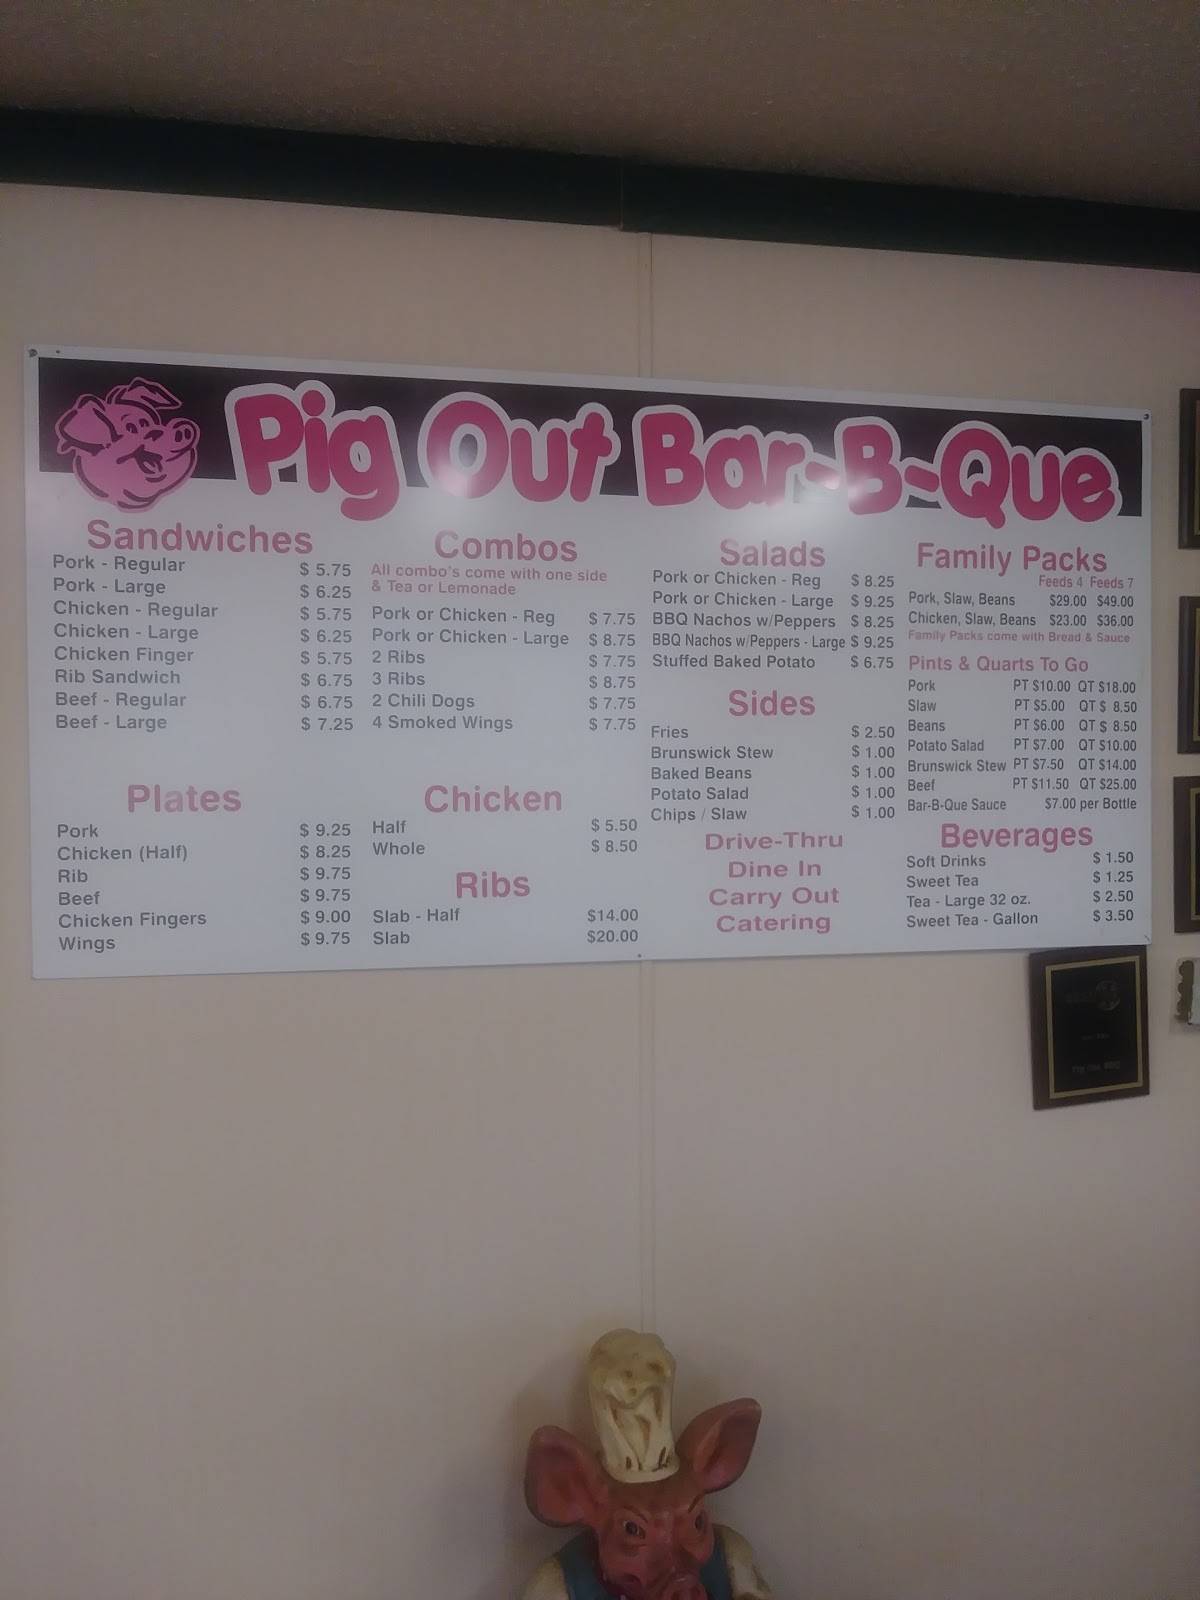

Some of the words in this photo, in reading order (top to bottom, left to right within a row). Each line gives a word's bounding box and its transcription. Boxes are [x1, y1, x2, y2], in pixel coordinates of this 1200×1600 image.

[232, 386, 399, 521] Pig
[424, 399, 616, 502] Out
[638, 411, 1114, 528] Bar-B-Que
[87, 519, 313, 554] Sandwiches
[435, 529, 578, 562] Combos
[720, 539, 826, 569] Salads
[918, 542, 1012, 577] Family
[1023, 545, 1107, 572] Packs
[53, 554, 95, 569] Pork
[114, 556, 185, 574] Regular
[371, 563, 390, 576] All
[395, 565, 460, 578] combo's
[465, 568, 505, 579] come
[510, 568, 541, 580] with
[545, 571, 573, 581] one
[577, 569, 607, 582] side
[653, 570, 688, 583] Pork
[714, 571, 776, 585] Chicken
[792, 573, 821, 590] Reg
[53, 577, 95, 592] Pork
[115, 579, 166, 597] Large
[387, 579, 412, 593] Tea
[438, 581, 516, 595] Lemonade
[1039, 574, 1073, 588] Feeds
[1090, 576, 1124, 589] Feeds
[653, 590, 688, 605] Pork
[714, 592, 776, 606] Chicken
[792, 593, 834, 610] Large
[909, 591, 939, 606] Pork,
[944, 591, 974, 607] Slaw,
[979, 592, 1015, 606] Beans
[1049, 594, 1087, 607] $29.00
[1097, 595, 1134, 608] $49.00
[53, 600, 129, 616] Chicken
[148, 602, 218, 621] Regular
[372, 606, 410, 620] Pork
[439, 607, 506, 622] Chicken
[524, 609, 555, 627] Reg
[653, 612, 688, 626] BBQ
[694, 612, 751, 627] Nachos
[756, 614, 836, 631] w/Peppers
[908, 611, 961, 627] Chicken,
[965, 611, 996, 627] Slaw,
[1000, 613, 1036, 626] Beans
[1050, 614, 1087, 626] $23.00
[1097, 614, 1134, 627] $36.00
[54, 623, 129, 638] Chicken
[148, 625, 199, 643] Large
[372, 627, 411, 642] Pork
[439, 629, 507, 644] Chicken
[524, 631, 569, 648] Large
[908, 629, 946, 643] Family
[949, 630, 984, 641] Packs
[987, 630, 1018, 641] come
[1022, 632, 1045, 642] with
[1048, 631, 1081, 642] Bread
[1096, 632, 1131, 643] Sauce
[653, 633, 681, 647] BBQ
[685, 633, 732, 647] Nachos
[736, 634, 800, 651] w/Peppers
[812, 635, 846, 651] Large
[54, 646, 129, 661] Chicken
[136, 647, 194, 665] Finger
[388, 650, 425, 664] Ribs
[653, 653, 708, 667] Stuffed
[714, 654, 761, 668] Baked
[767, 655, 815, 668] Potato
[909, 655, 952, 671] Pints
[977, 656, 1034, 671] Quarts
[1040, 656, 1059, 672] To
[1065, 657, 1088, 672] Go
[55, 669, 85, 683] Rib
[92, 669, 180, 684] Sandwich
[388, 672, 426, 686] Ribs
[908, 679, 936, 692] Pork
[1033, 679, 1071, 692] $10.00
[1098, 681, 1136, 694] $18.00
[56, 692, 97, 706] Beef
[116, 692, 186, 710] Regular
[388, 693, 426, 707] Chili
[432, 694, 475, 711] Dogs
[729, 689, 815, 717] Sides
[908, 698, 937, 712] Slaw
[1034, 699, 1065, 712] $5.00
[56, 714, 98, 729] Beef
[116, 714, 167, 733] Large
[388, 715, 456, 729] Smoked
[462, 715, 513, 733] Wings
[908, 719, 946, 732] Beans
[1033, 718, 1065, 731] $6.00
[651, 725, 689, 739] Fries
[651, 746, 731, 759] Brunswick
[737, 746, 773, 759] Stew
[908, 739, 947, 752] Potato
[951, 739, 984, 752] Salad
[1033, 738, 1064, 751] $7.00
[1099, 739, 1137, 752] $10.00
[908, 759, 972, 772] Brunswick
[977, 759, 1007, 772] Stew
[1033, 758, 1064, 770] $7.50
[1099, 758, 1137, 771] $14.00
[651, 767, 699, 780] Baked
[705, 766, 752, 779] Beans
[908, 778, 935, 791] Beef
[1031, 778, 1069, 790] $11.50
[1099, 778, 1137, 790] $25.00
[128, 784, 242, 813] Plates
[424, 785, 562, 813] Chicken
[651, 787, 701, 800] Potato
[706, 787, 749, 800] Salad
[908, 798, 968, 811] Bar-B-Que
[971, 798, 1007, 811] Sauce
[1045, 797, 1076, 810] $7.00
[1080, 800, 1099, 812] per
[1103, 797, 1137, 810] Bottle
[651, 808, 696, 824] Chips
[711, 807, 747, 820] Slaw
[57, 824, 98, 838] Pork
[373, 820, 406, 834] Half
[705, 832, 843, 850] Drive-Thru
[941, 823, 1093, 853] Beverages
[57, 846, 132, 861] Chicken
[139, 844, 187, 863] (Half)
[372, 841, 425, 856] Whole
[729, 861, 788, 878] Dine
[799, 860, 821, 877] In
[907, 855, 935, 868] Soft
[941, 854, 986, 867] Drinks
[58, 869, 88, 883] Rib
[906, 875, 951, 888] Sweet
[955, 874, 979, 887] Tea
[456, 871, 530, 899] Ribs
[59, 891, 100, 906] Beef
[709, 888, 782, 909] Carry
[792, 887, 839, 904] Out
[906, 895, 930, 908] Tea
[945, 895, 985, 910] Large
[1011, 895, 1030, 905] oz.
[59, 913, 133, 928] Chicken
[140, 912, 207, 929] Fingers
[373, 909, 410, 923] Slab
[427, 908, 460, 922] Half
[587, 908, 638, 923] $14.00
[906, 915, 950, 928] Sweet
[954, 914, 979, 926] Tea
[993, 912, 1038, 925] Gallon
[716, 914, 831, 934] Catering
[59, 936, 116, 953] Wings
[373, 931, 410, 945] Slab
[587, 929, 638, 944] $20.00
